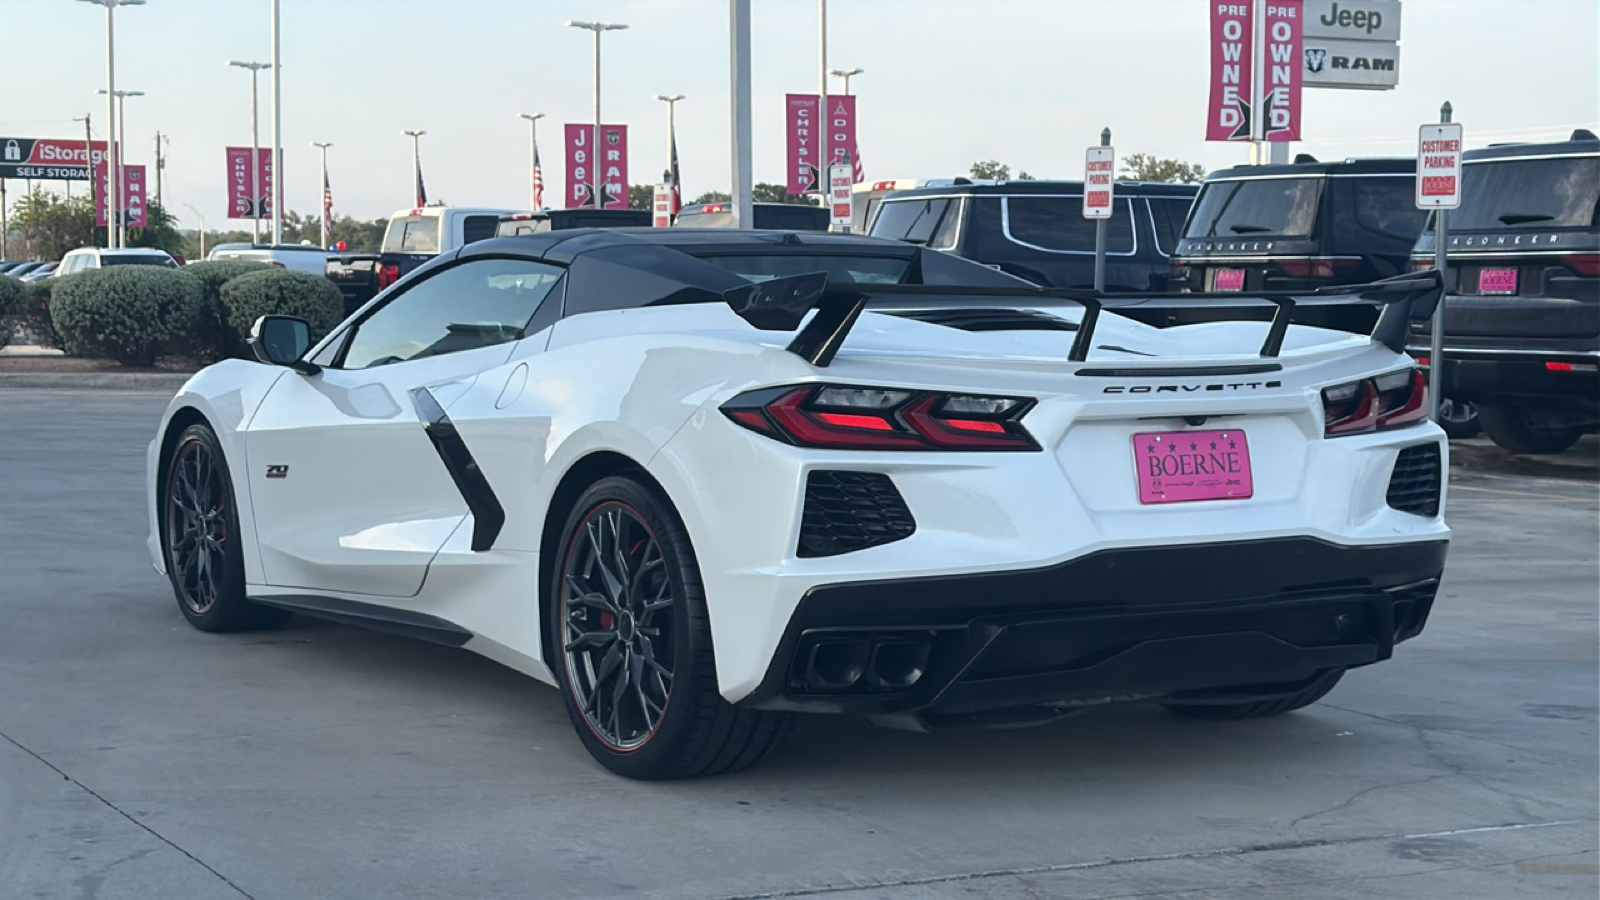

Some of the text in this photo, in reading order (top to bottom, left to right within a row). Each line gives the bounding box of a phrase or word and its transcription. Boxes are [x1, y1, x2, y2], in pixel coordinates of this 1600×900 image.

[1218, 5, 1247, 16] PRE
[1267, 6, 1296, 18] PRE
[1320, 2, 1382, 34] Jeep
[1331, 55, 1394, 71] RAM
[1220, 20, 1242, 127] OWNED
[1270, 21, 1293, 127] OWNED
[798, 109, 809, 185] CHRYSLER
[1421, 140, 1459, 153] CUSTOMER
[16, 167, 97, 178] SELF STORA
[574, 129, 586, 200] Jeep
[606, 149, 621, 194] RAM
[1425, 156, 1455, 169] PARKING
[129, 183, 141, 215] RAM
[1452, 234, 1559, 246] AGONEER
[1103, 380, 1281, 394] CORVETTE
[1147, 452, 1241, 477] BOERNE
